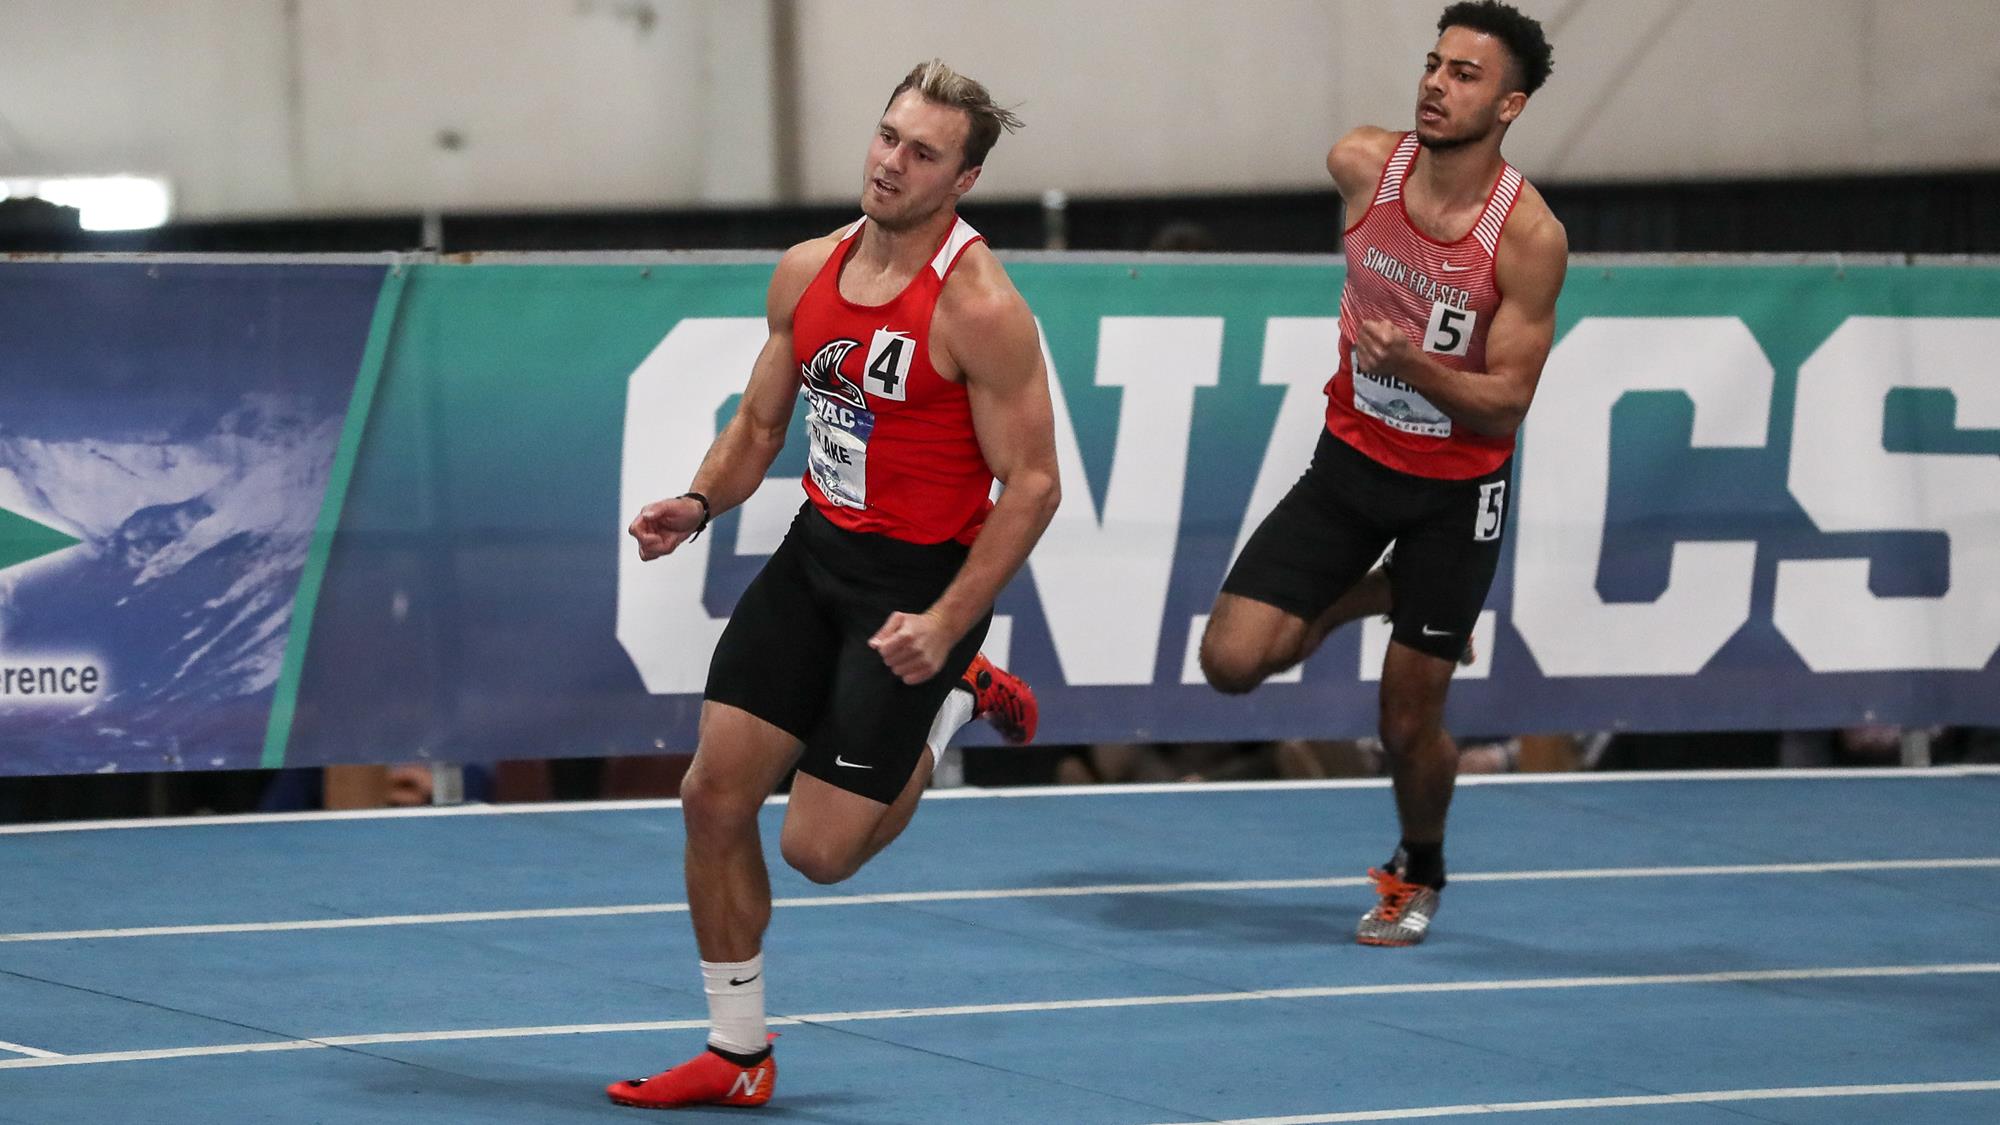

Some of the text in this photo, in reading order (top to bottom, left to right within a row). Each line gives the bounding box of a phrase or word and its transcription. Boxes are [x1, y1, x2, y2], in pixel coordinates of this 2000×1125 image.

[1363, 247, 1470, 310] SIMON FRASER
[1434, 309, 1466, 352] 5
[868, 338, 904, 394] 4
[1484, 487, 1502, 539] 5
[0, 665, 98, 694] rence
